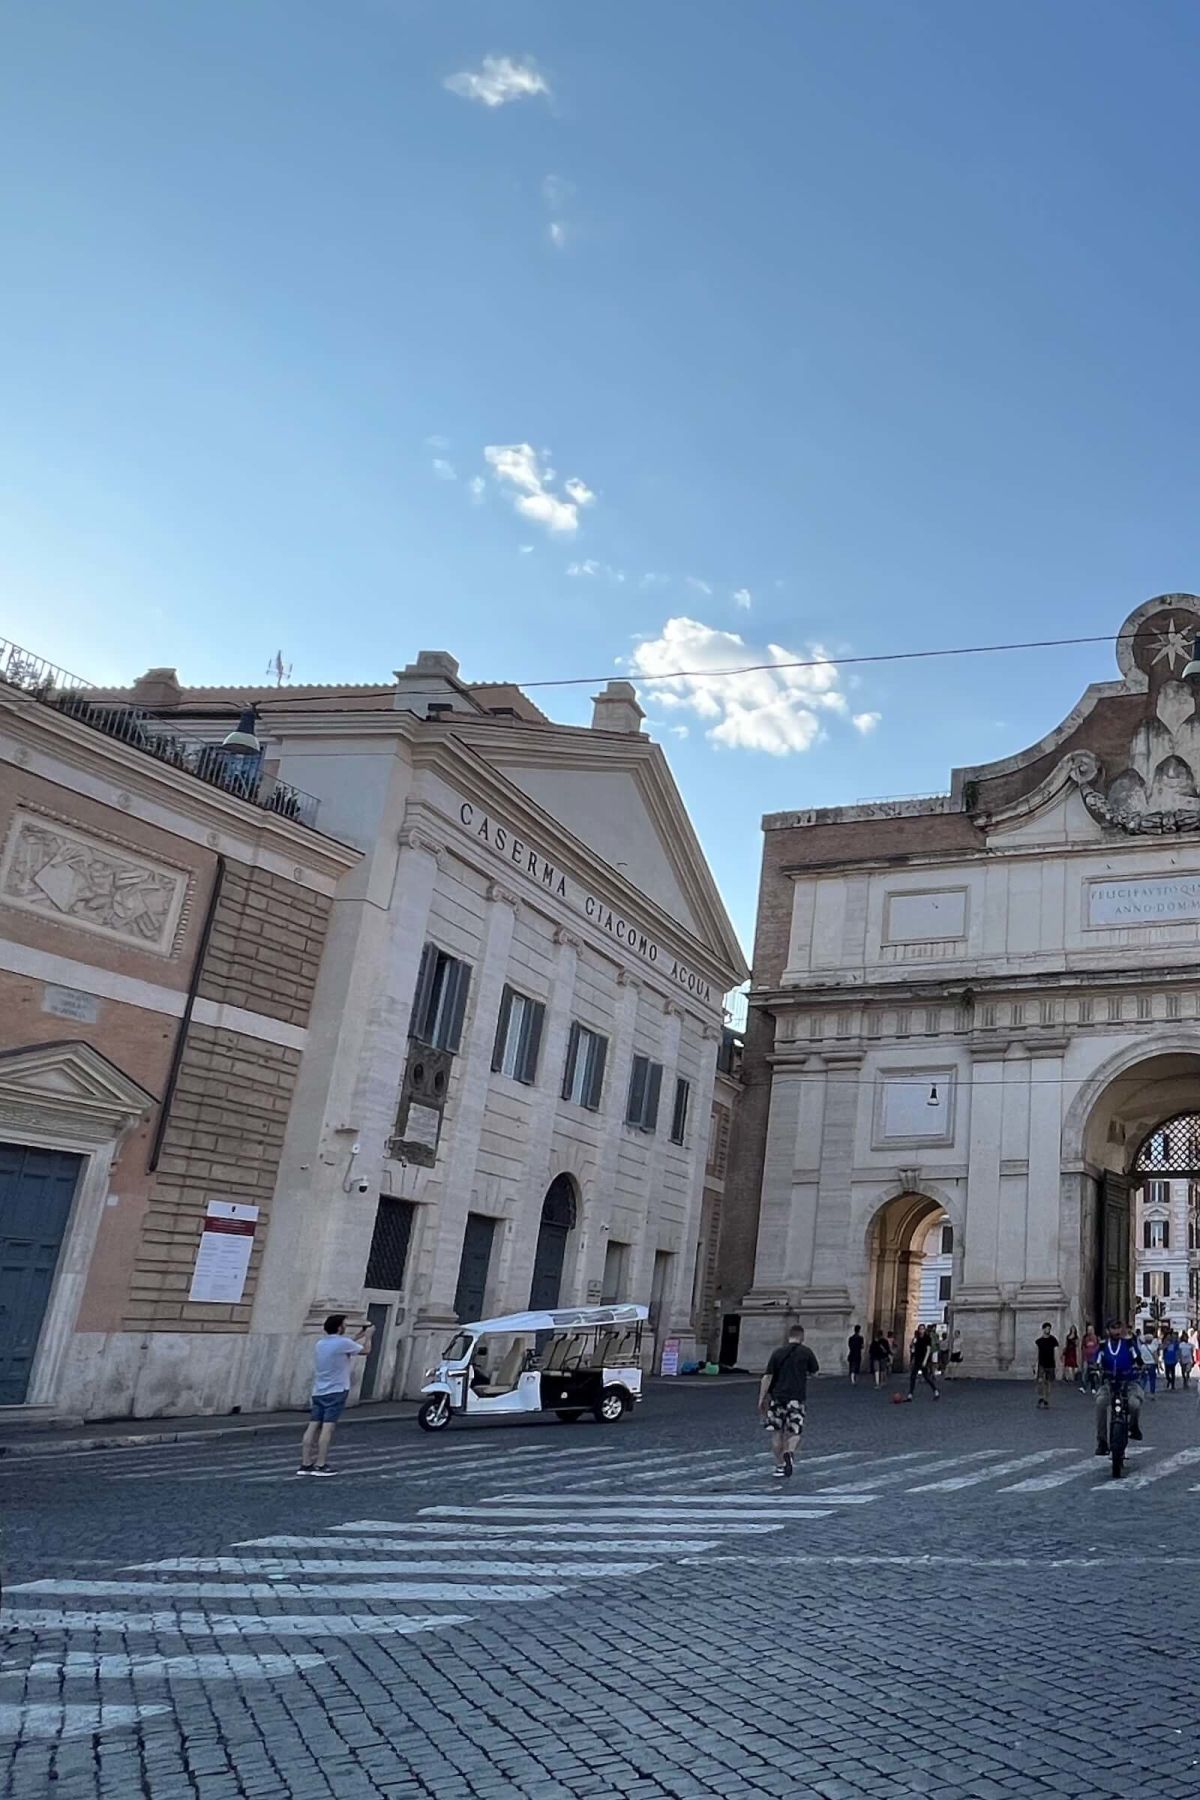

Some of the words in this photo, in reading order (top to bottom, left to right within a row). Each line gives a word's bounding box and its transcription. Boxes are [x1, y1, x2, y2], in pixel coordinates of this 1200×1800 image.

[460, 803, 567, 897] CASERMA
[585, 897, 657, 961] GIACOMO
[670, 961, 710, 1002] ACQUA
